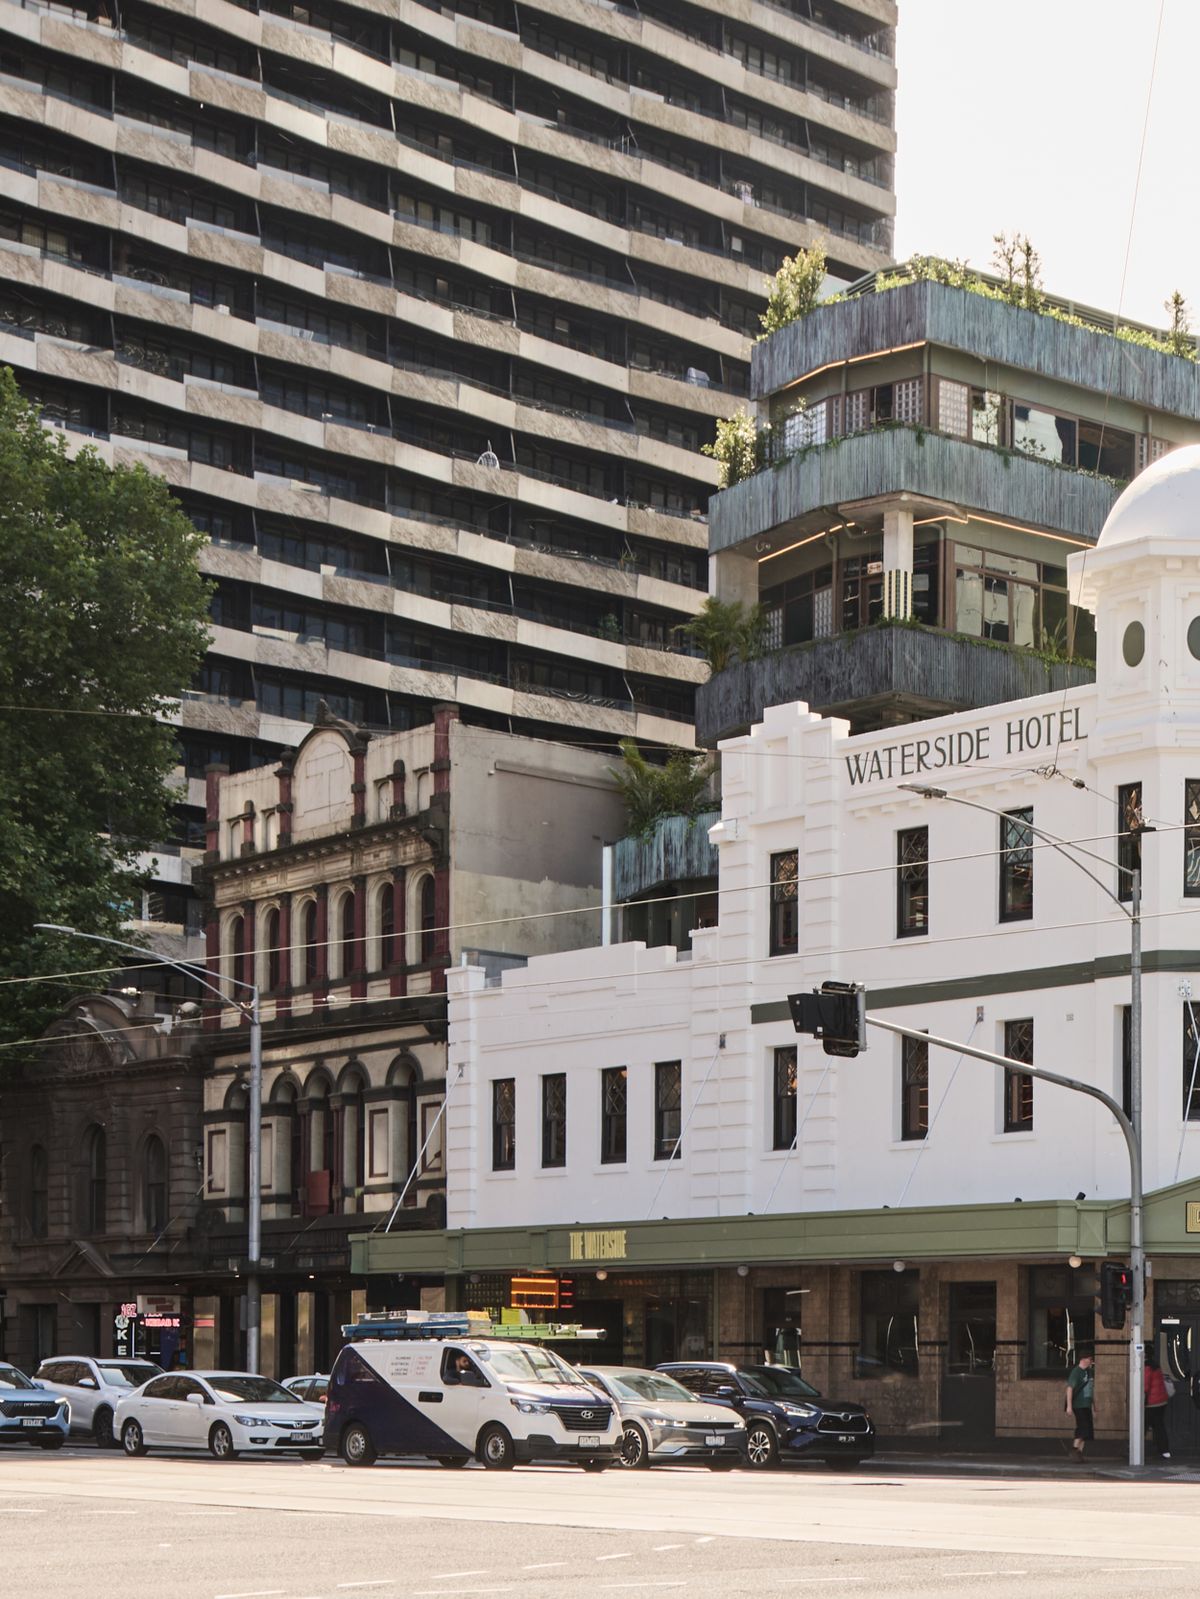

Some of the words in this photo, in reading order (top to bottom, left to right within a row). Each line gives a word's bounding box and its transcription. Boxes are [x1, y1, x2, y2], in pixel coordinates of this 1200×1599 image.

[844, 726, 990, 786] WATERSIDE
[1006, 707, 1089, 755] HOTEL
[569, 1231, 583, 1260] THE
